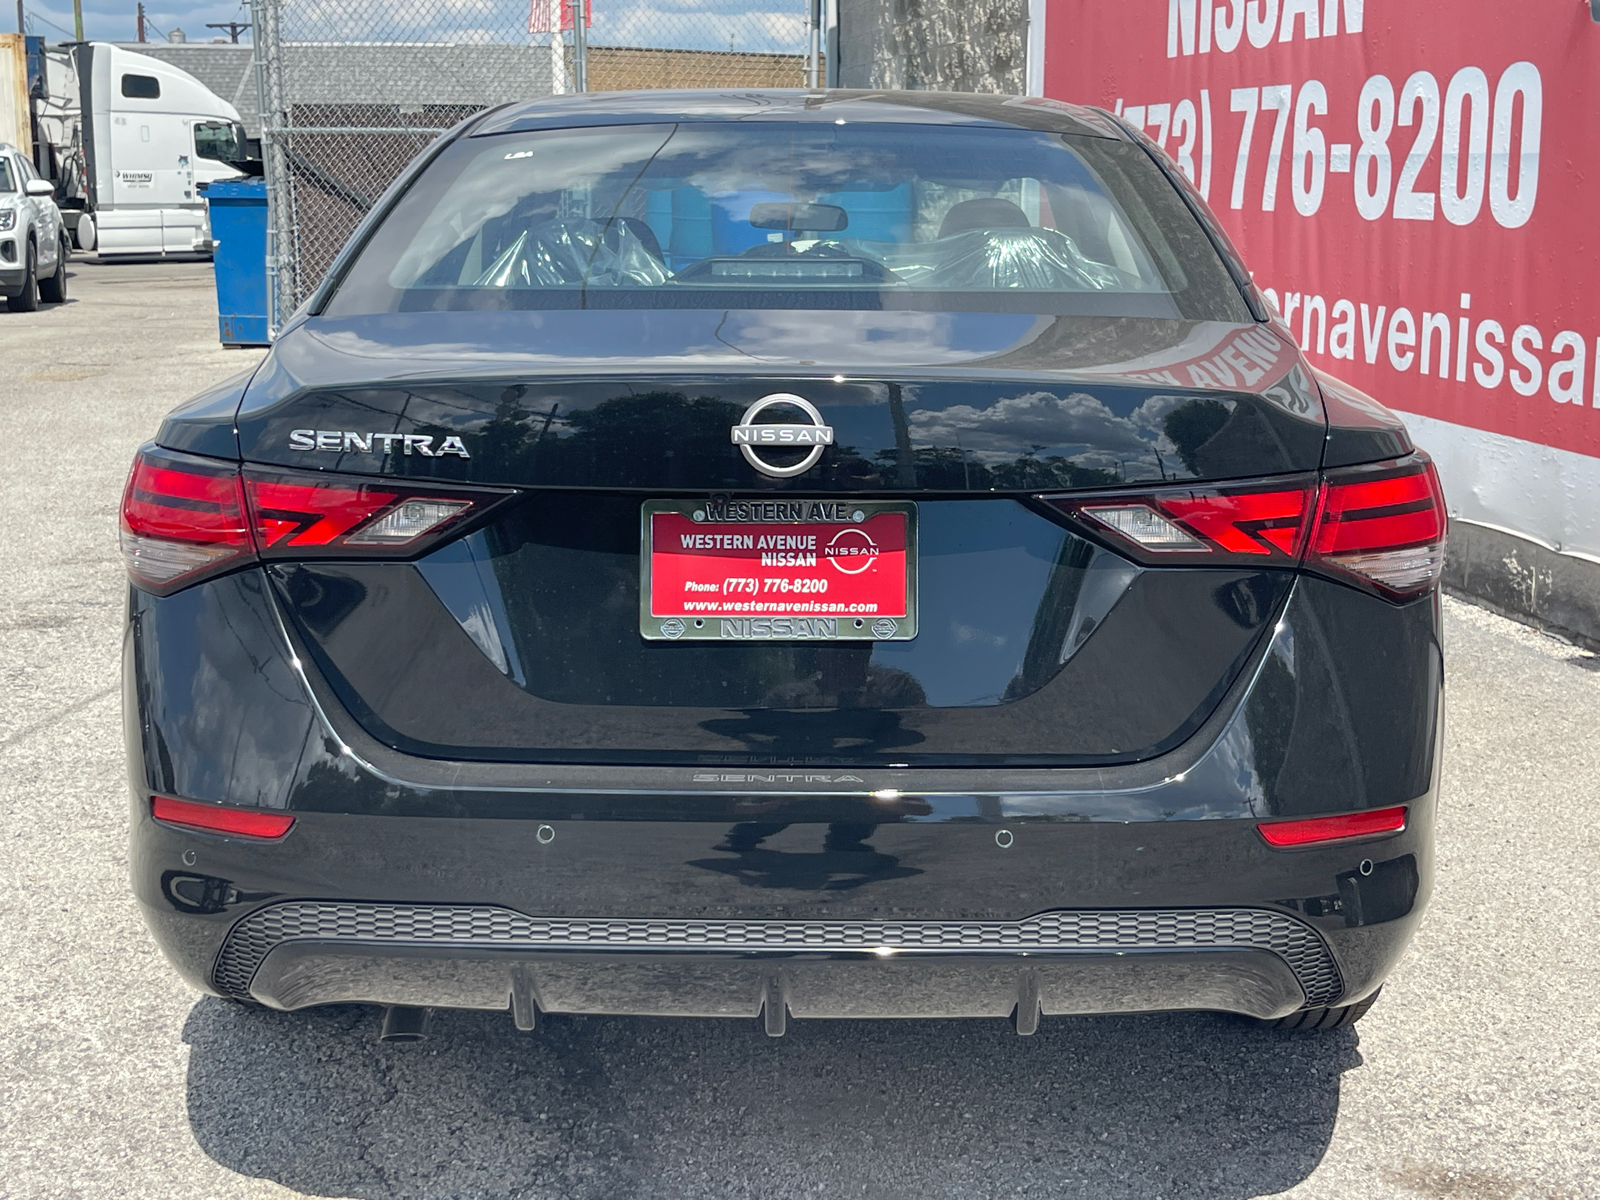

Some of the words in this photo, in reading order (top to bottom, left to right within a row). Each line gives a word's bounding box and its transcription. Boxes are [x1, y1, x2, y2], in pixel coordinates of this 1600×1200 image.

[1230, 61, 1543, 229] 776-8200
[288, 429, 471, 459] SENTRA
[734, 429, 832, 443] NISSAN
[705, 502, 802, 522] WESTERN
[681, 534, 754, 550] WESTERN
[757, 535, 817, 550] AVENUE
[761, 552, 817, 567] NISSAN
[825, 547, 879, 556] NISSAN
[684, 581, 719, 592] Phone:
[723, 578, 760, 596] (773)
[763, 578, 828, 594] 776-8200
[684, 600, 878, 613] www.westernavenissan.com
[720, 618, 839, 638] NISSAN
[693, 774, 864, 783] SENTRA
